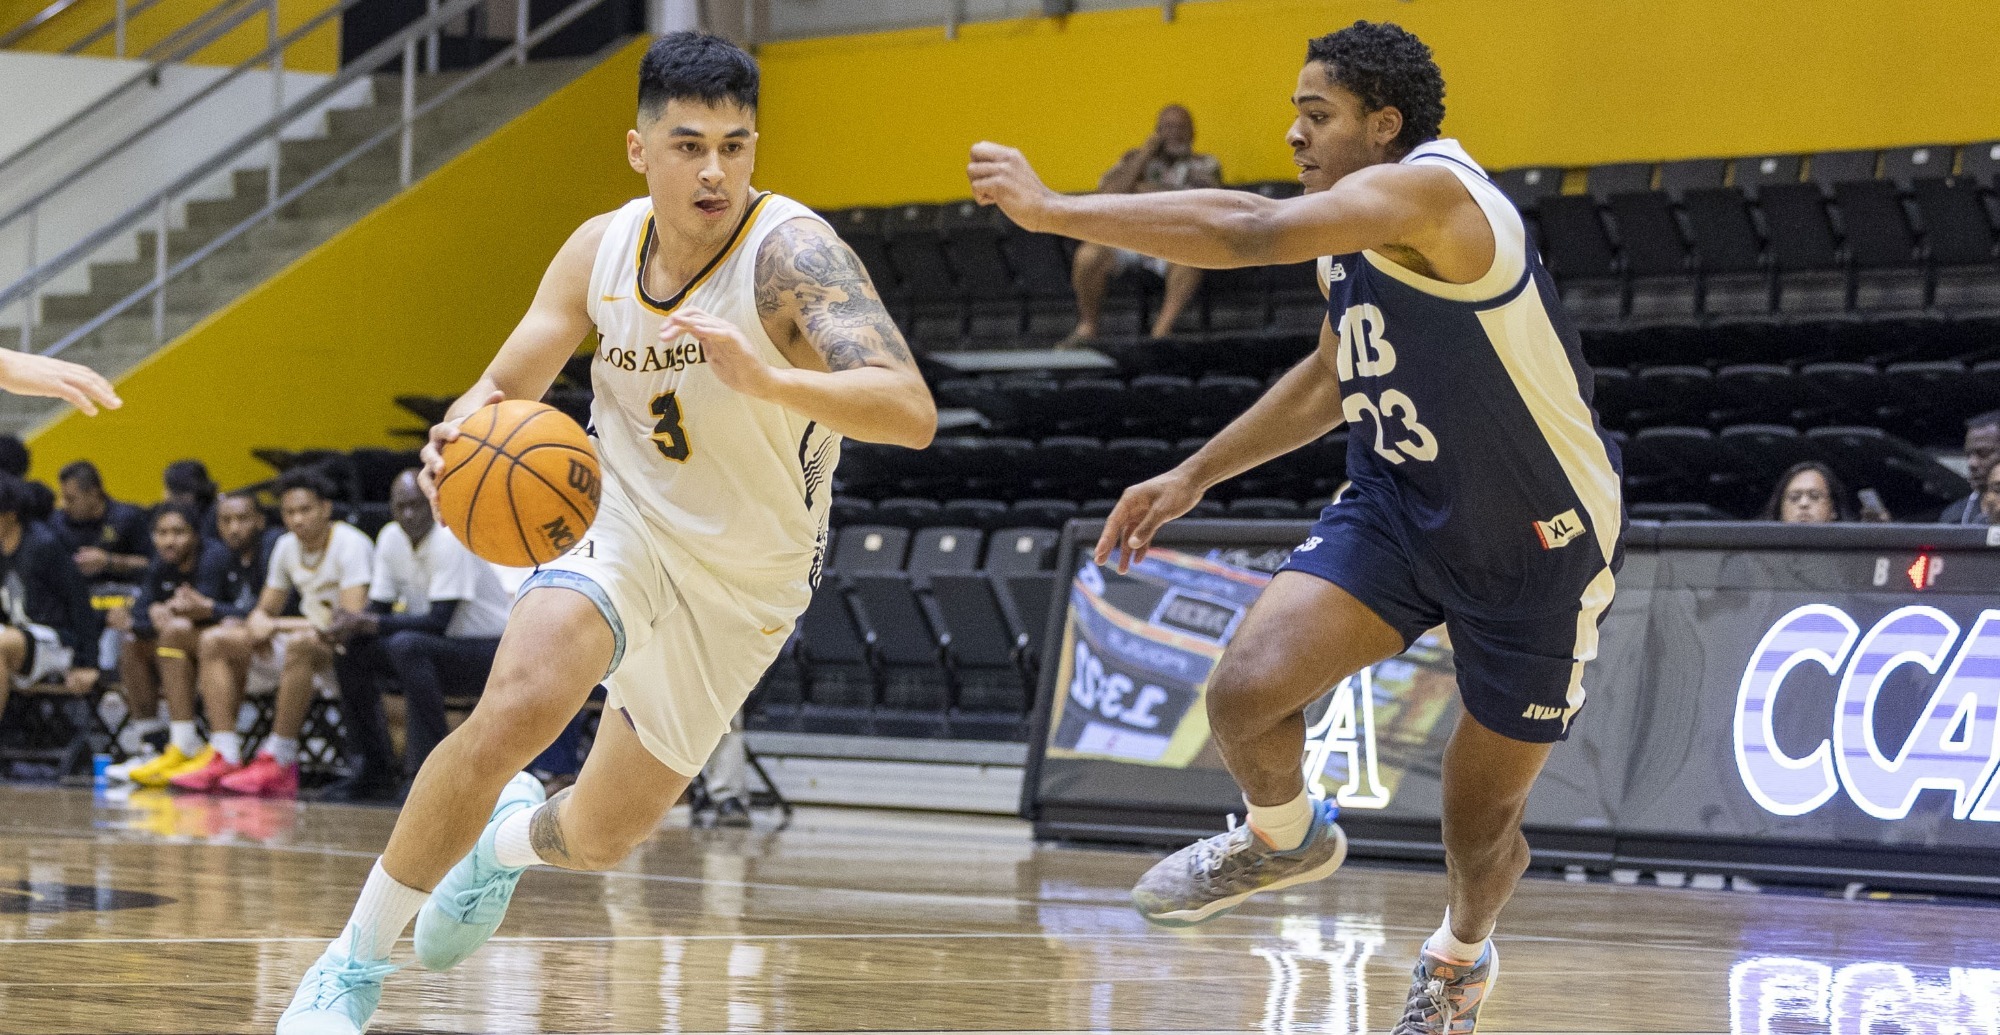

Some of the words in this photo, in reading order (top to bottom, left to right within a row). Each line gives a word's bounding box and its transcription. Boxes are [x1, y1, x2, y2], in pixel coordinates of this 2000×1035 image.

[597, 333, 637, 371] Los
[639, 339, 708, 373] Angel
[648, 389, 693, 464] 3
[1341, 388, 1439, 465] 23
[1547, 518, 1574, 539] XL
[1872, 556, 1891, 587] B
[1926, 555, 1945, 587] P
[1302, 664, 1391, 810] A
[1733, 602, 2000, 822] CCA
